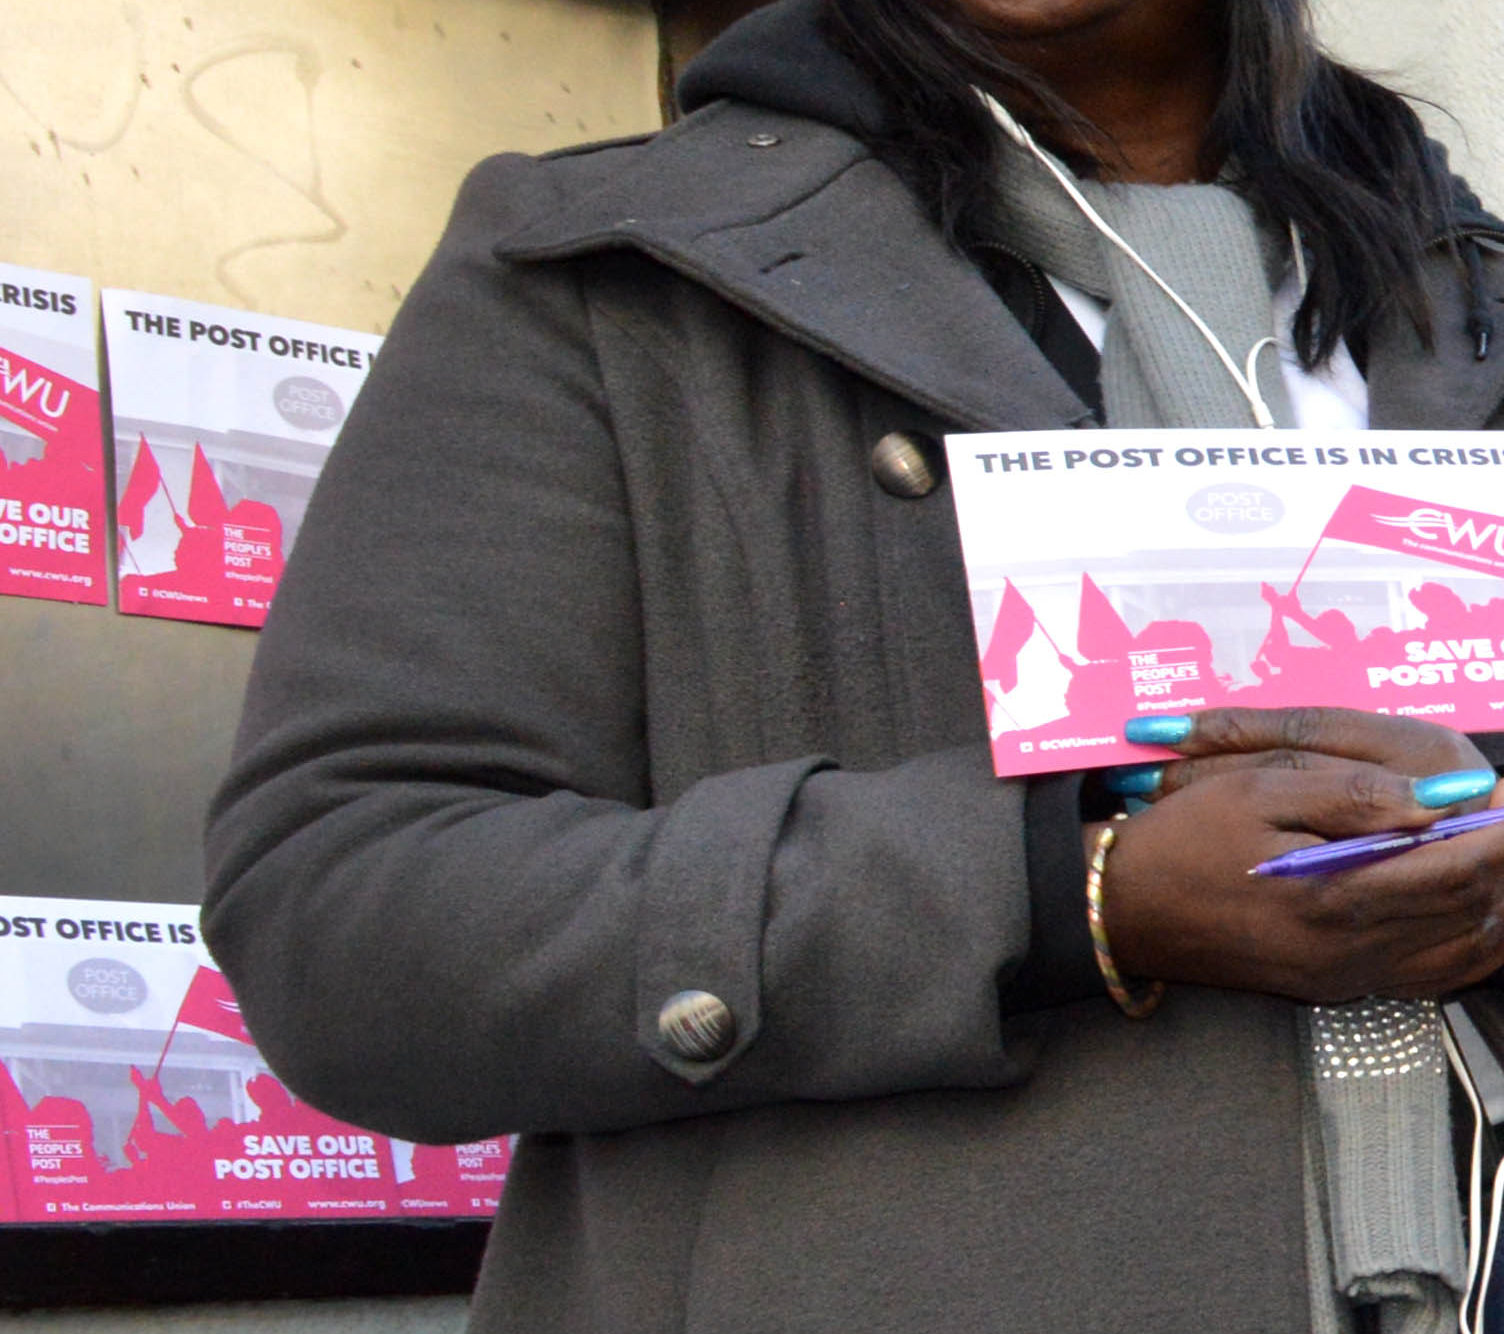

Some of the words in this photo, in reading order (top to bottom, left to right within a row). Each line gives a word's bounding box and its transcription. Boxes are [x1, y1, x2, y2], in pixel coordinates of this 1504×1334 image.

[0, 281, 77, 316] RISIS
[124, 310, 182, 338] THE
[189, 320, 262, 352] POST
[268, 335, 363, 370] OFFICE
[288, 384, 330, 405] POST
[278, 397, 338, 421] OFFICE
[975, 451, 1053, 473] THE
[1063, 448, 1163, 469] POST
[1174, 447, 1307, 467] OFFICE
[1315, 447, 1349, 466] IS
[1359, 447, 1398, 466] IN
[1207, 491, 1266, 507] POST
[28, 502, 91, 531] OUR
[1195, 505, 1274, 523] OFFICE
[0, 524, 91, 555] OFFICE
[224, 554, 253, 568] POST
[1128, 652, 1158, 667] THE
[1404, 638, 1495, 662] SAVE
[1131, 664, 1199, 682] PEOPLE'S
[1366, 662, 1459, 688] POST
[1134, 681, 1173, 697] POST
[55, 918, 163, 943] OFFICE
[168, 923, 196, 944] IS
[84, 967, 130, 984] POST
[75, 982, 138, 1001] OFFICE
[26, 1128, 50, 1140] THE
[243, 1134, 313, 1156] SAVE
[316, 1134, 376, 1156] OUR
[31, 1158, 62, 1169] POST
[214, 1158, 285, 1181] POST
[288, 1157, 381, 1180] OFFICE
